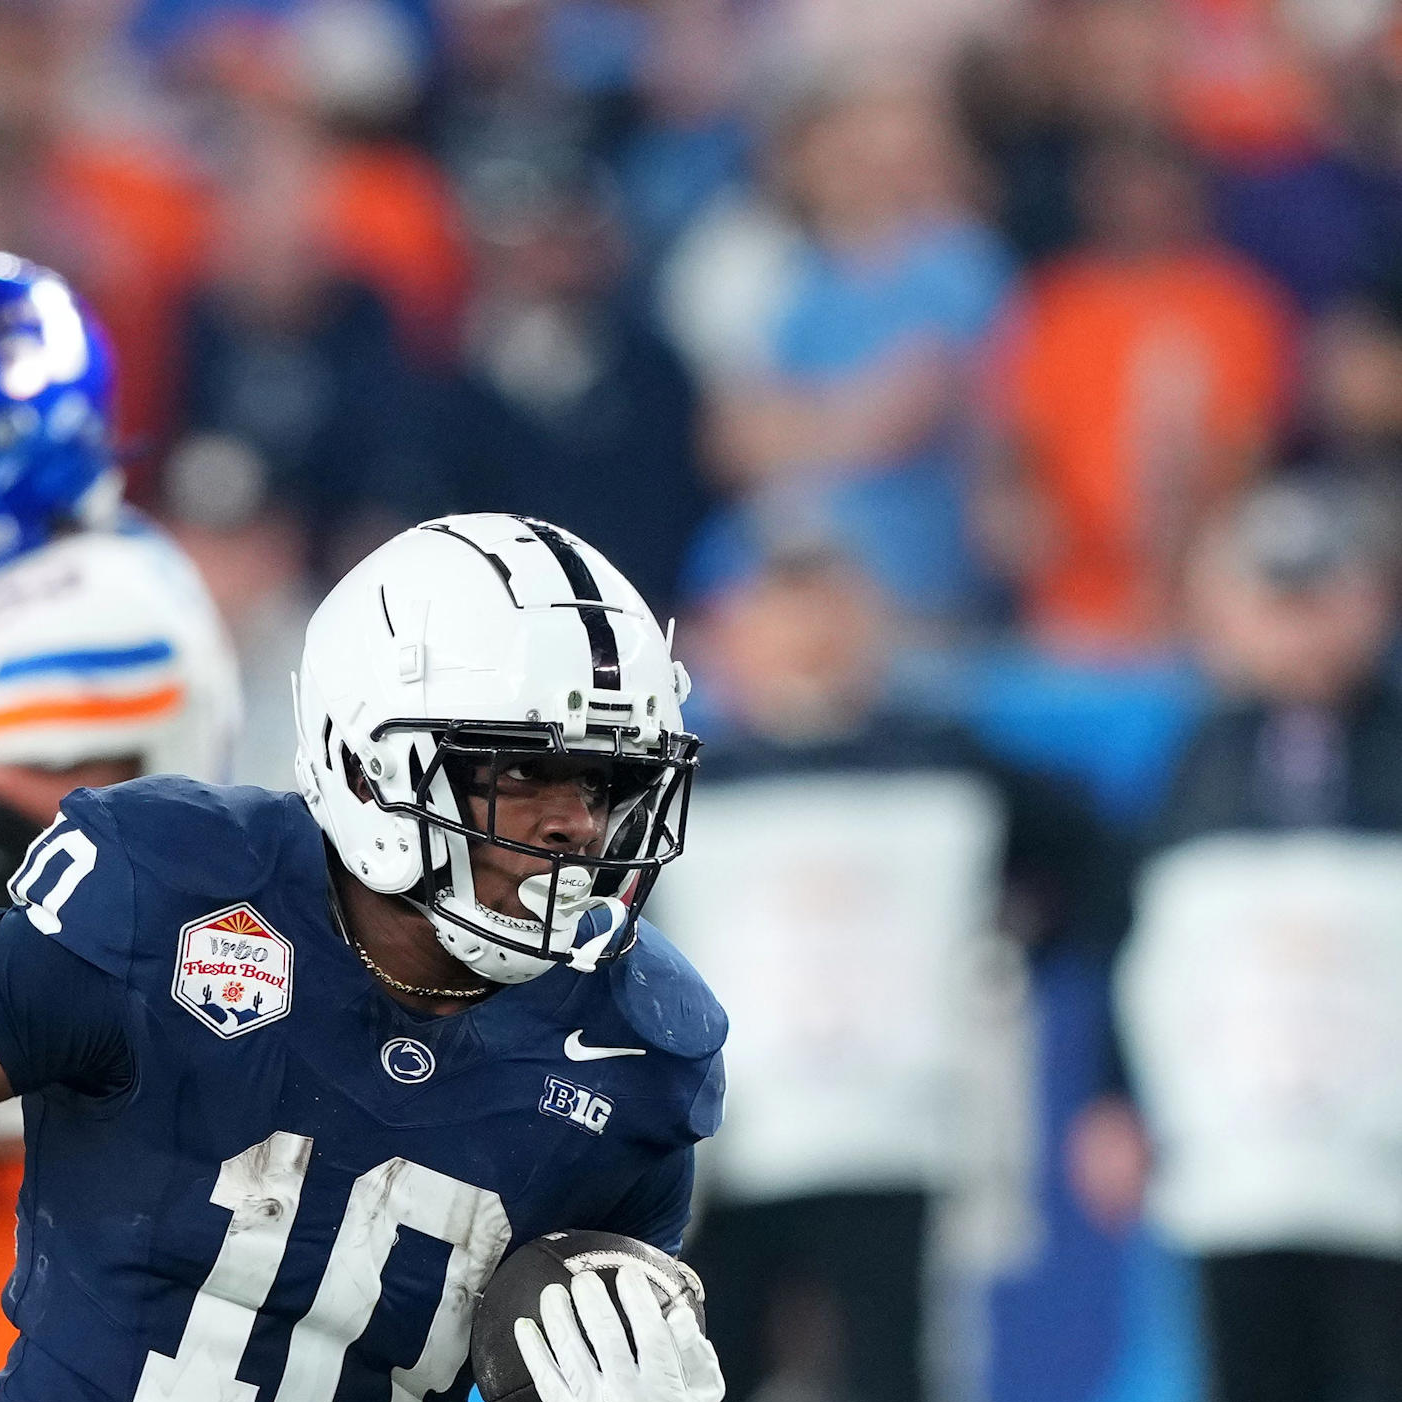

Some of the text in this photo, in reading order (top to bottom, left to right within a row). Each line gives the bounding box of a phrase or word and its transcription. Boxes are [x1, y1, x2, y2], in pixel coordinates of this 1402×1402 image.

[209, 936, 269, 963] Vrbo
[183, 960, 286, 990] Fiesta Bowl
